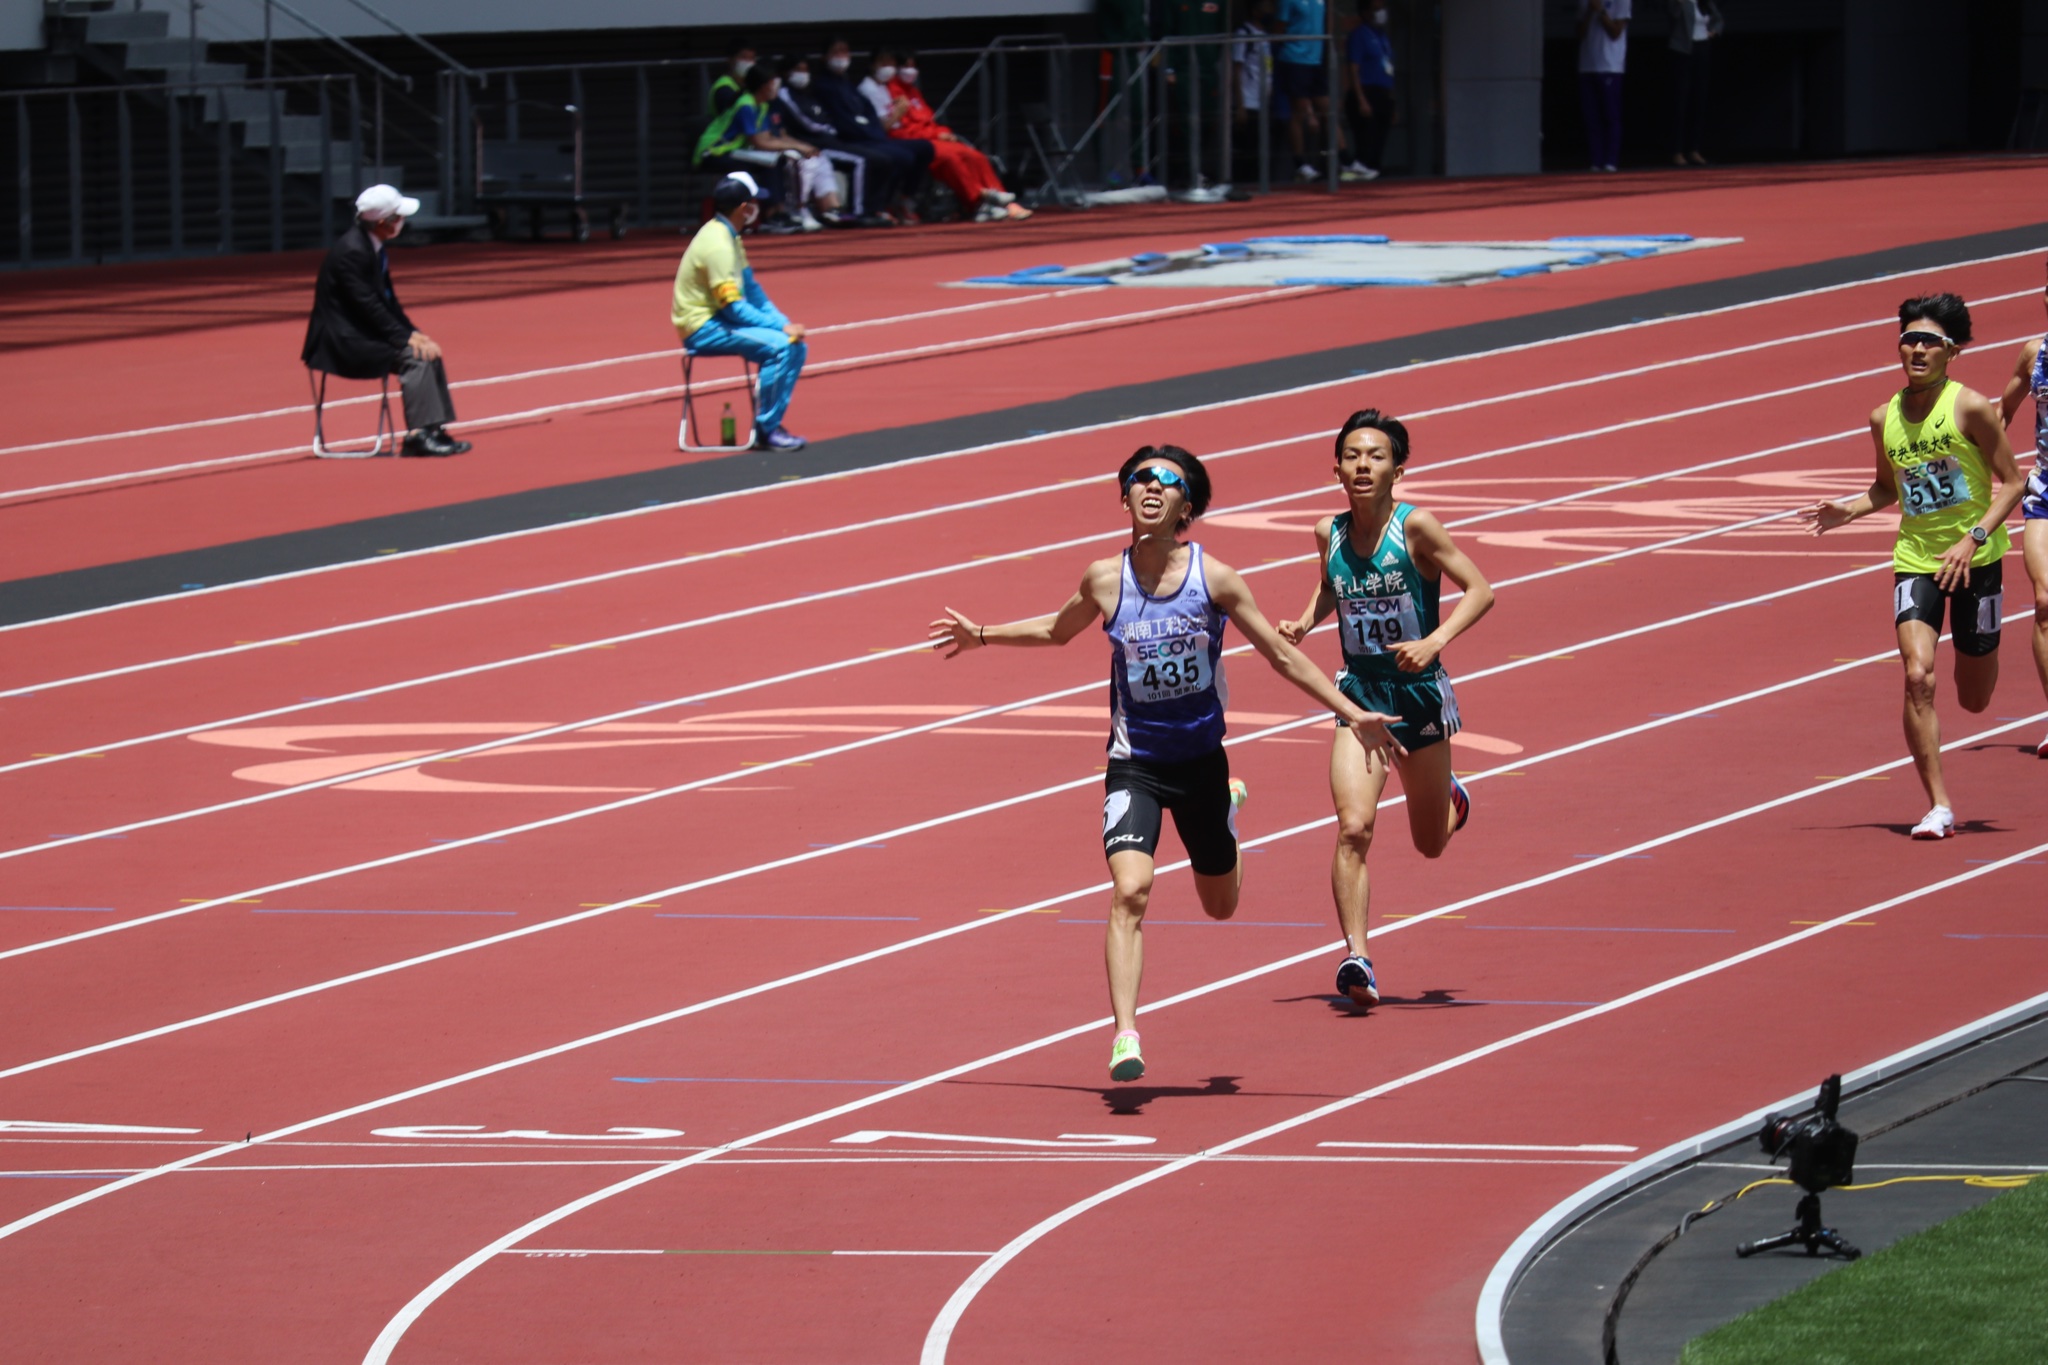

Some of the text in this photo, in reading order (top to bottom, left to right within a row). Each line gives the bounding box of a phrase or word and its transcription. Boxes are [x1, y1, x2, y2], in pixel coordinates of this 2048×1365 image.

[1904, 460, 1948, 481] SECOM
[1910, 475, 1954, 507] 515
[1333, 571, 1407, 598] 青山学院
[1349, 599, 1401, 615] SECOM
[1353, 618, 1402, 645] 149
[1137, 638, 1196, 660] SECOM
[1142, 656, 1199, 691] 435
